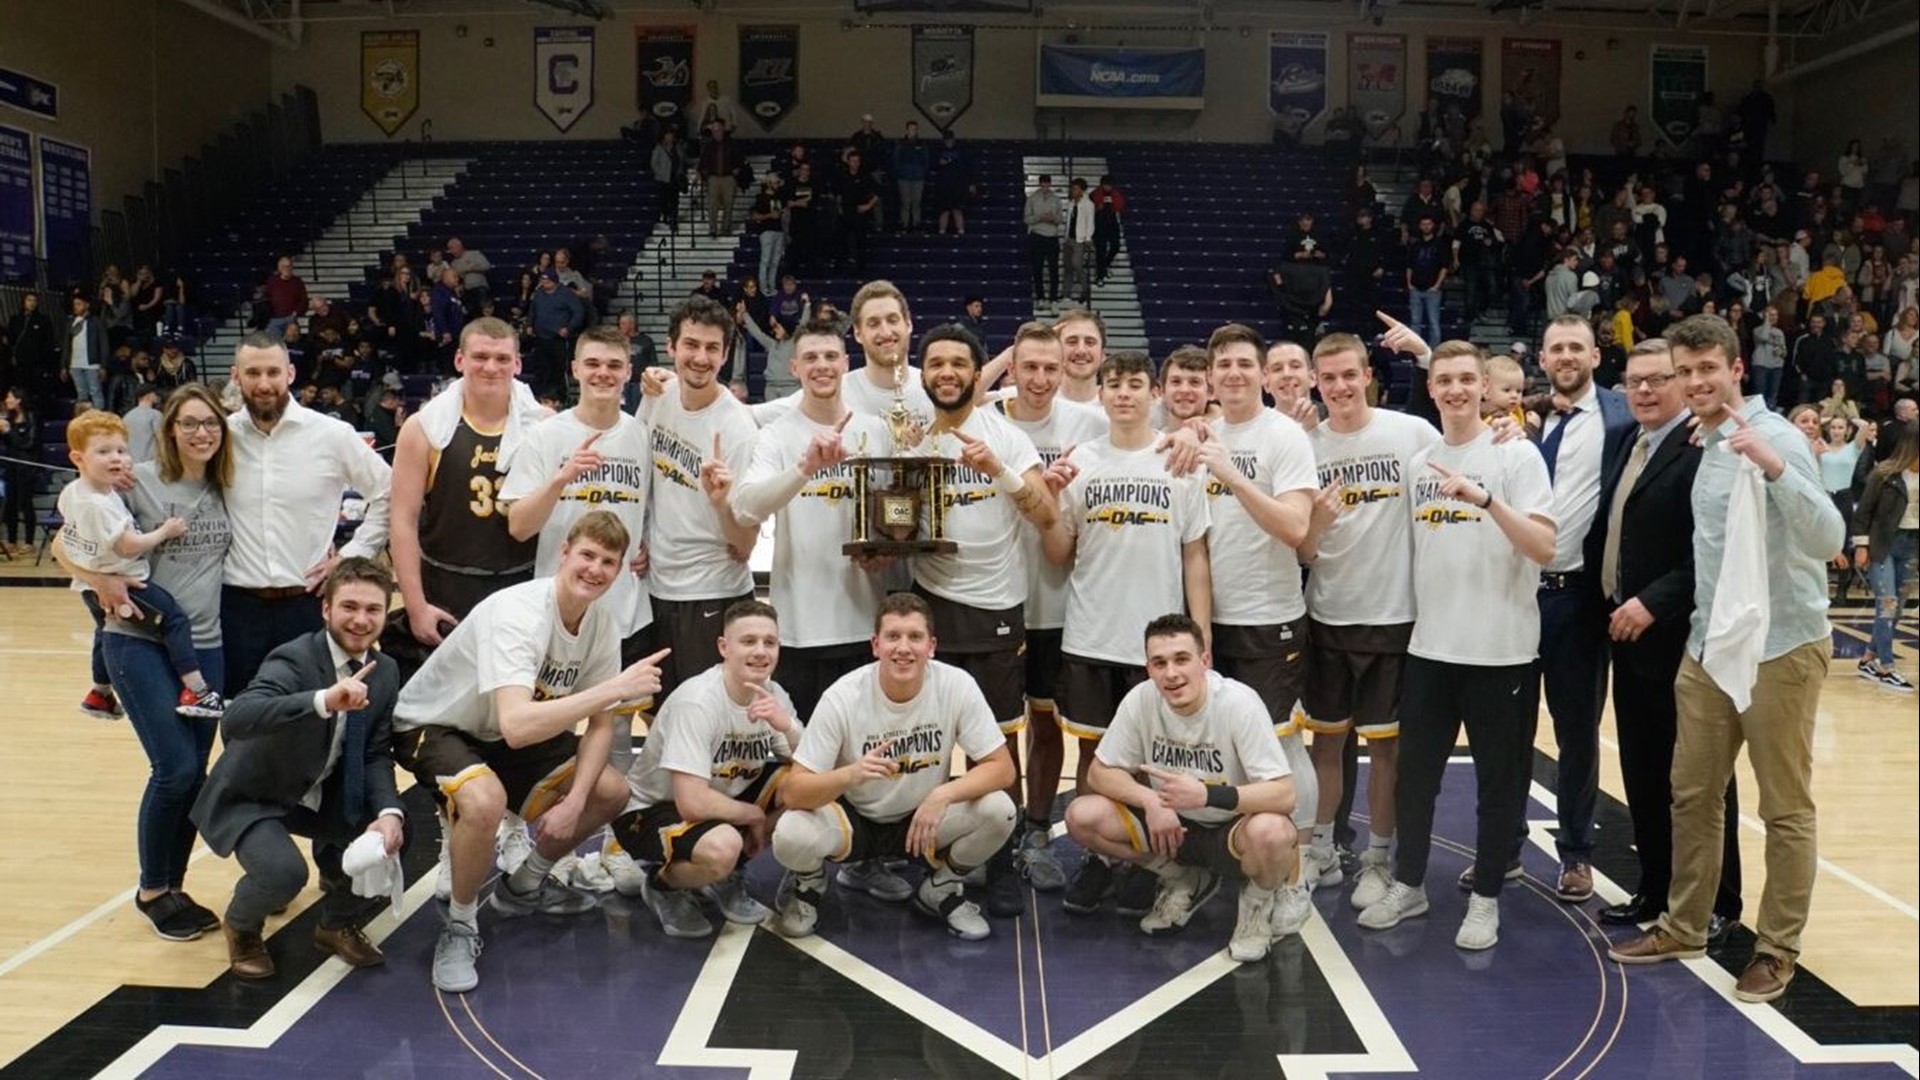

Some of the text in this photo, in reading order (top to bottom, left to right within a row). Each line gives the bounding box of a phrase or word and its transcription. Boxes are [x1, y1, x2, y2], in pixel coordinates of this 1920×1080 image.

[1089, 70, 1160, 84] NCAA.com
[560, 463, 641, 490] AMPIONS
[589, 490, 623, 504] OAC
[829, 486, 856, 500] OA
[1085, 483, 1171, 509] CHAMPIONS
[1346, 489, 1380, 505] OAC
[1112, 511, 1148, 525] OAC
[1430, 510, 1461, 523] OAC
[1152, 740, 1225, 773] CHAMPIONS
